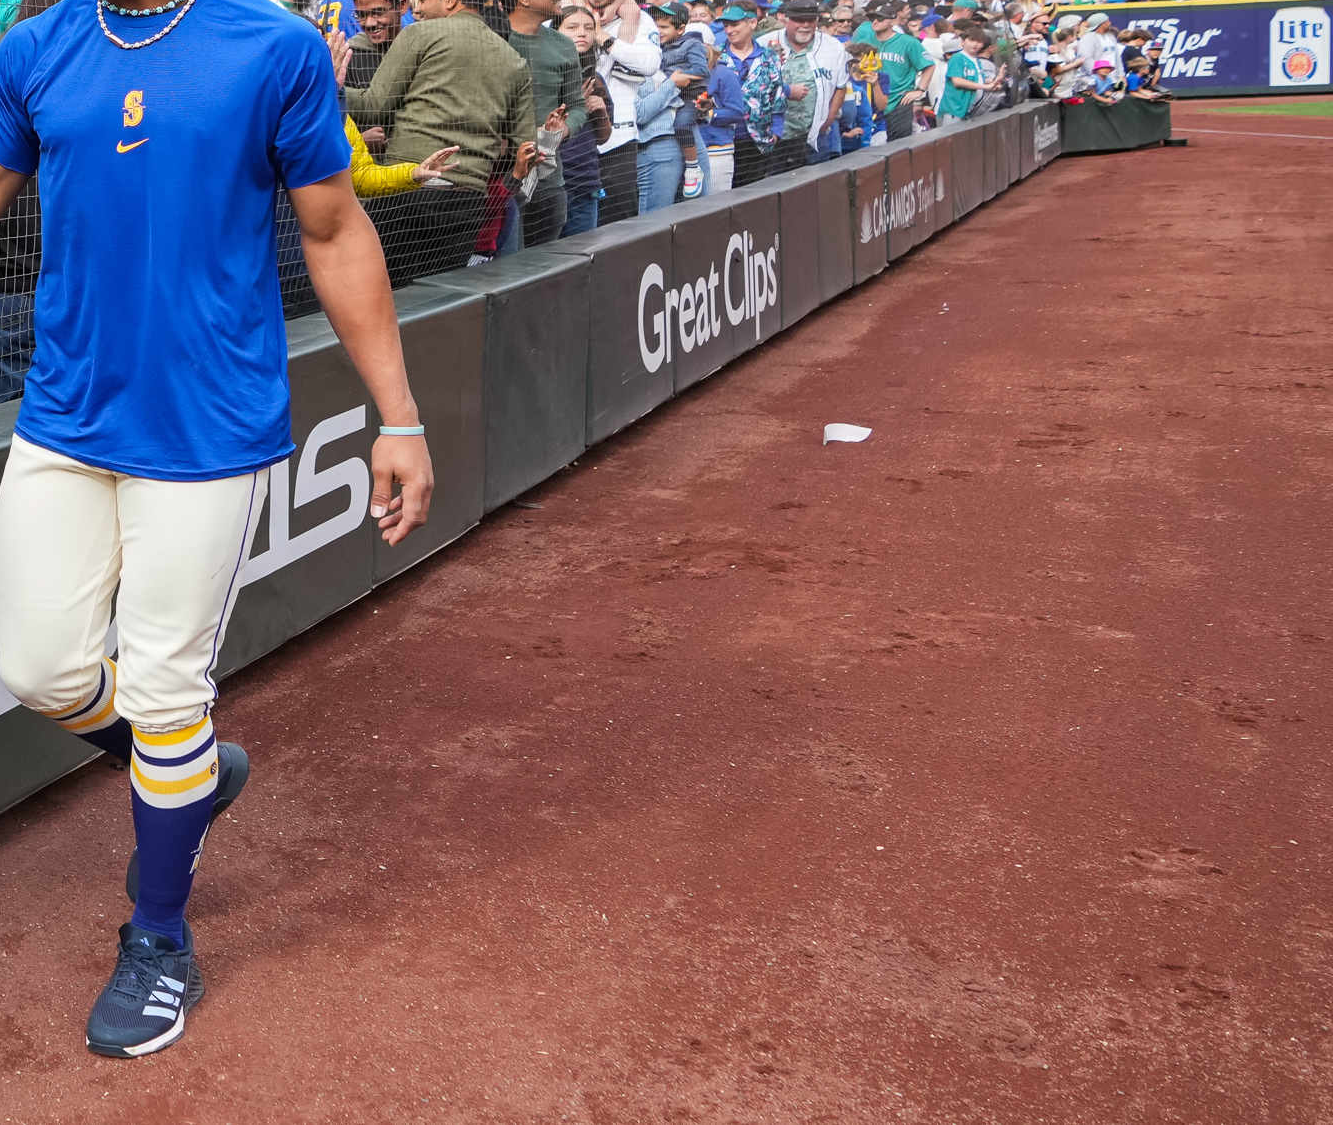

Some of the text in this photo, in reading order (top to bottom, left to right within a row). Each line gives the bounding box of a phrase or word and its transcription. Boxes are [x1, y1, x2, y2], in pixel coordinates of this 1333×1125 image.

[1127, 18, 1180, 35] IT'S
[1277, 20, 1323, 44] Lite
[122, 90, 146, 127] S
[637, 229, 778, 373] Great Clips
